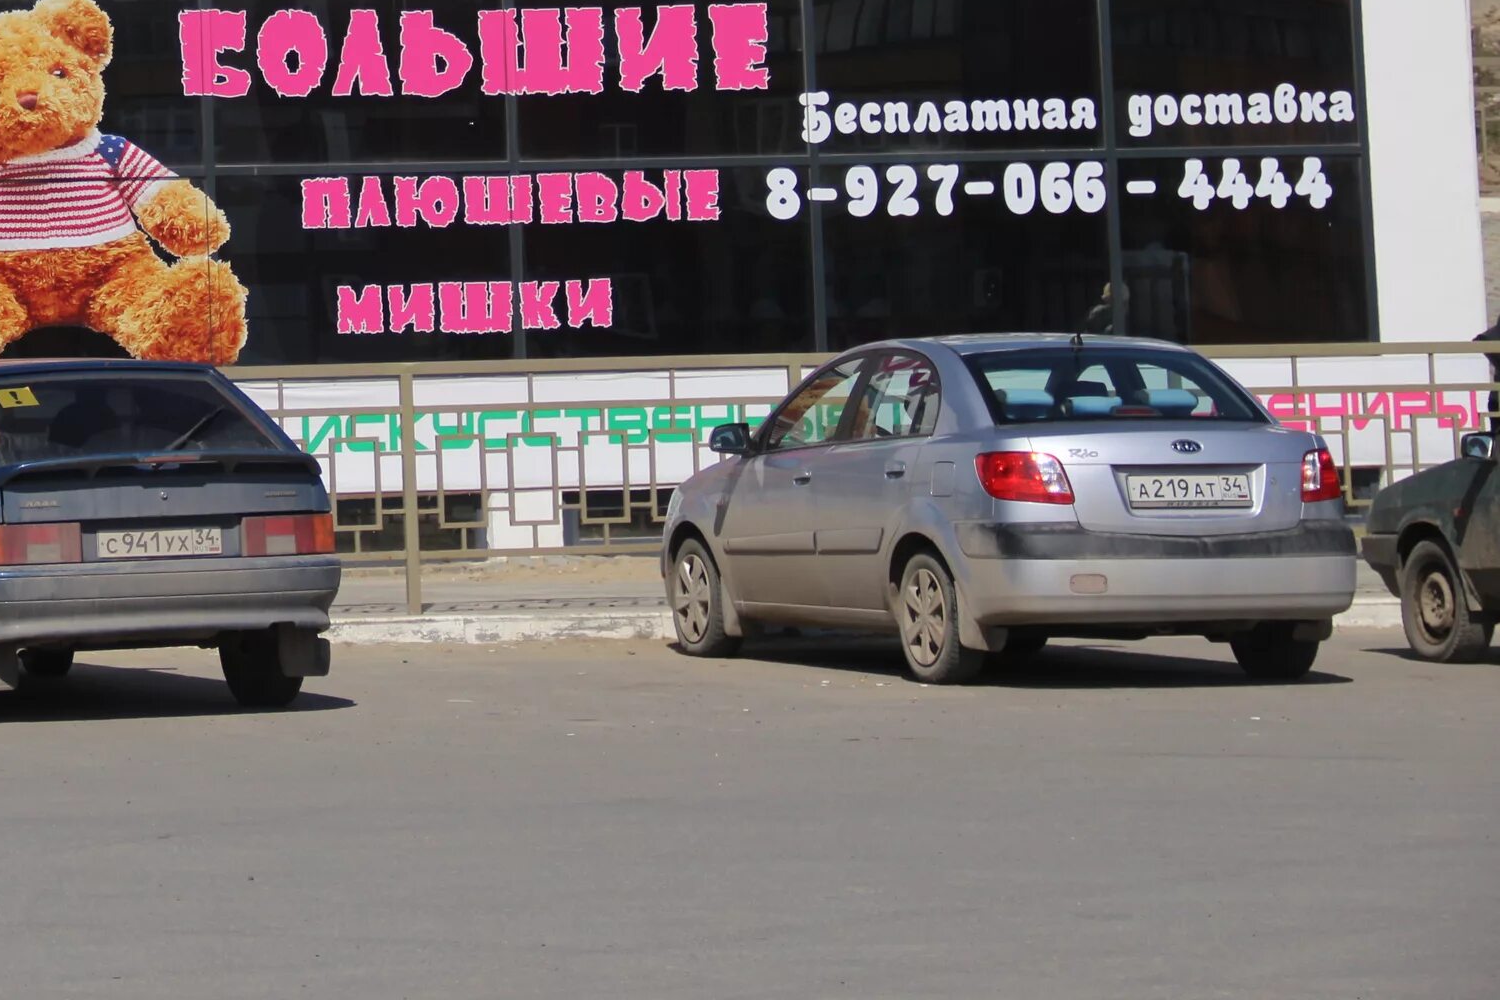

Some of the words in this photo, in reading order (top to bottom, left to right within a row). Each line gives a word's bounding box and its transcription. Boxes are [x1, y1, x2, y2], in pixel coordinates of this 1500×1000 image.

[178, 3, 771, 98] БОЛЬШИЕ
[799, 91, 1097, 144] Бесплатная
[1128, 82, 1355, 138] доставка
[301, 170, 722, 229] ПЛЮШЕВЫЕ
[337, 279, 613, 334] МИШКИ
[1257, 390, 1480, 431] ЕНИРЫ
[1068, 448, 1099, 458] Rio
